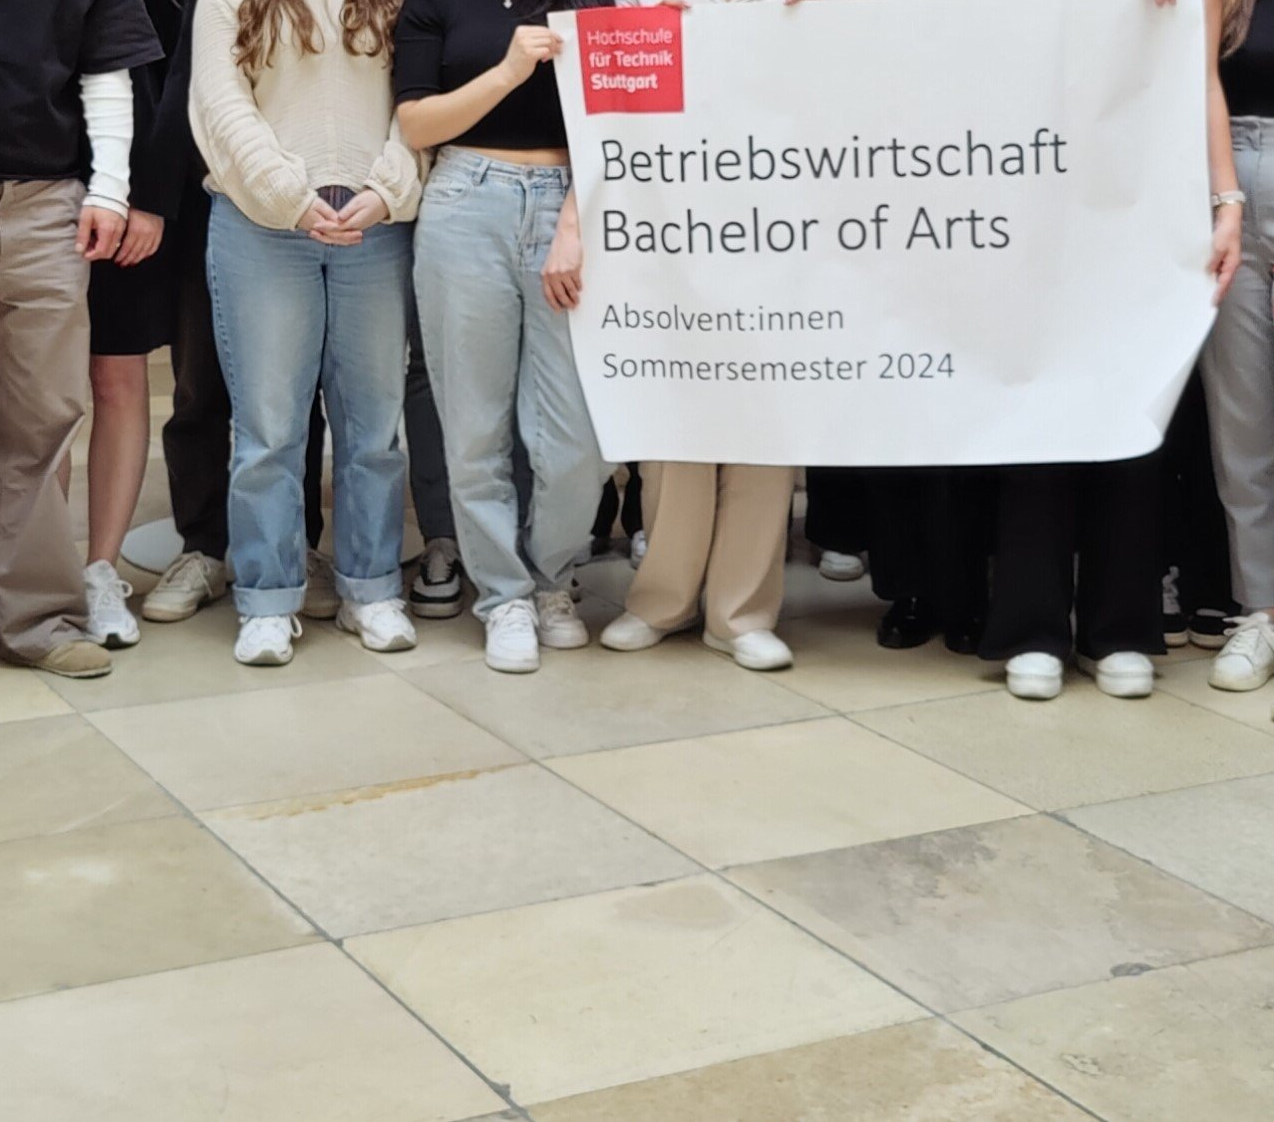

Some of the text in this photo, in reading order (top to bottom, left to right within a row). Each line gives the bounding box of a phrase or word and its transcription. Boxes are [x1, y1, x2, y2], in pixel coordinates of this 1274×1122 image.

[587, 27, 674, 47] Hochschule
[589, 49, 674, 69] für Technik
[591, 72, 658, 93] Stuttgart
[601, 128, 1068, 184] Betriebswirtschaft
[601, 204, 1011, 255] Bachelor of Arts
[601, 303, 845, 333] Absolvent:innen
[602, 353, 956, 382] Sommersemester 2024
